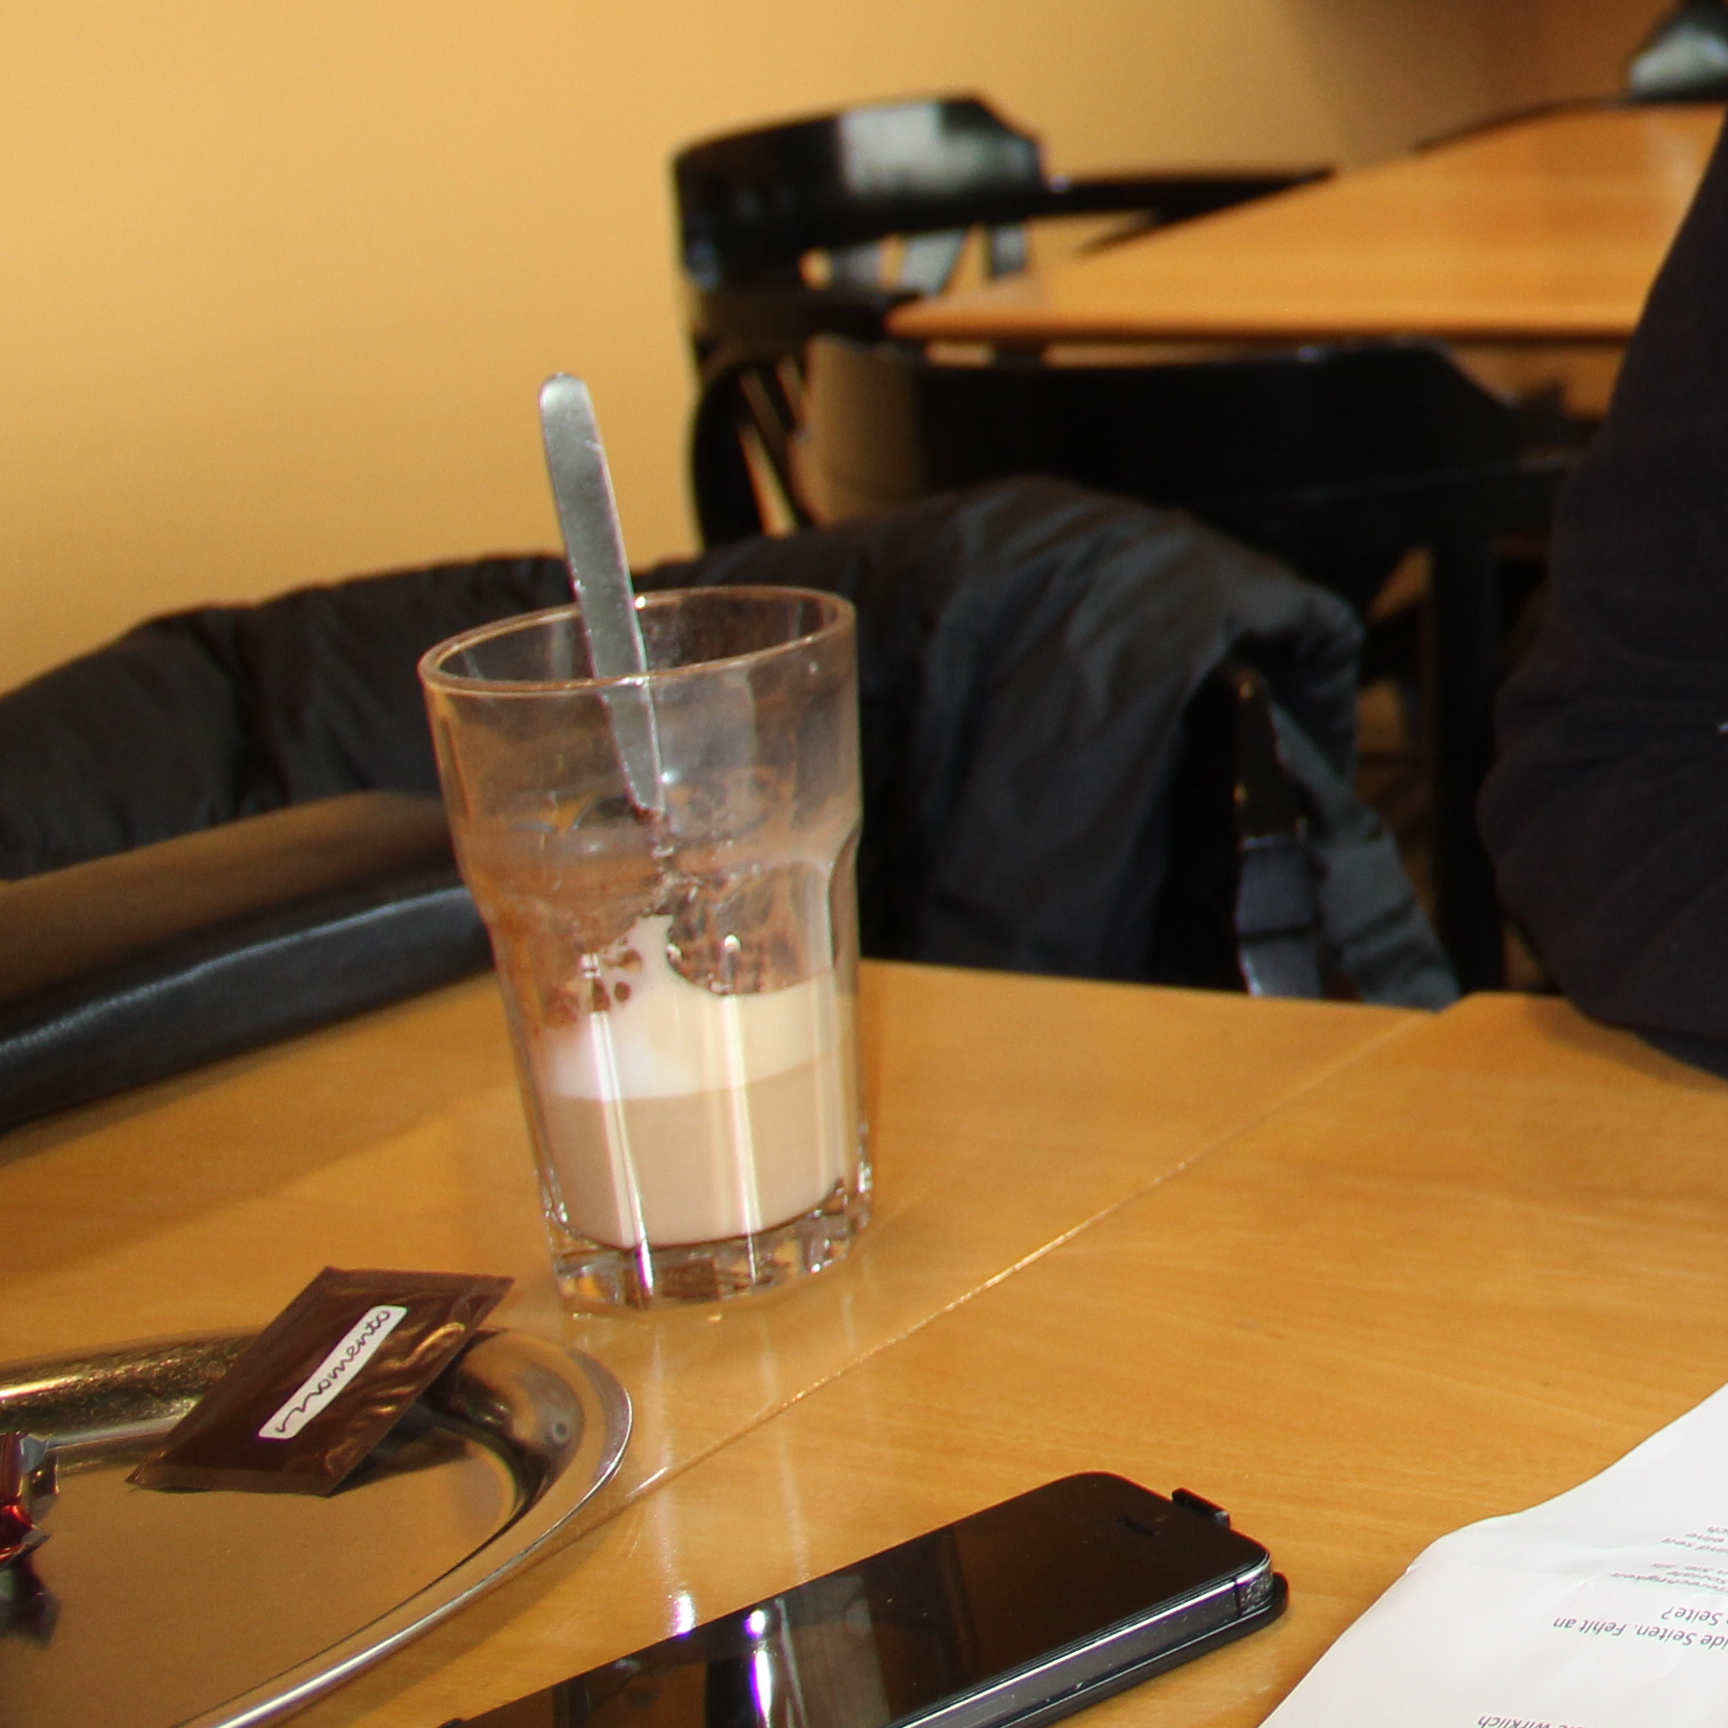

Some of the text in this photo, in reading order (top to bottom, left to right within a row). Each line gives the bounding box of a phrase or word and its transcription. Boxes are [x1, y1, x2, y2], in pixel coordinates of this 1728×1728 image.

[275, 1310, 391, 1433] momento
[1553, 1616, 1577, 1631] an
[1661, 1604, 1723, 1627] Seite?
[1578, 1618, 1627, 1639] Fehlt
[1633, 1624, 1698, 1647] Seiten.
